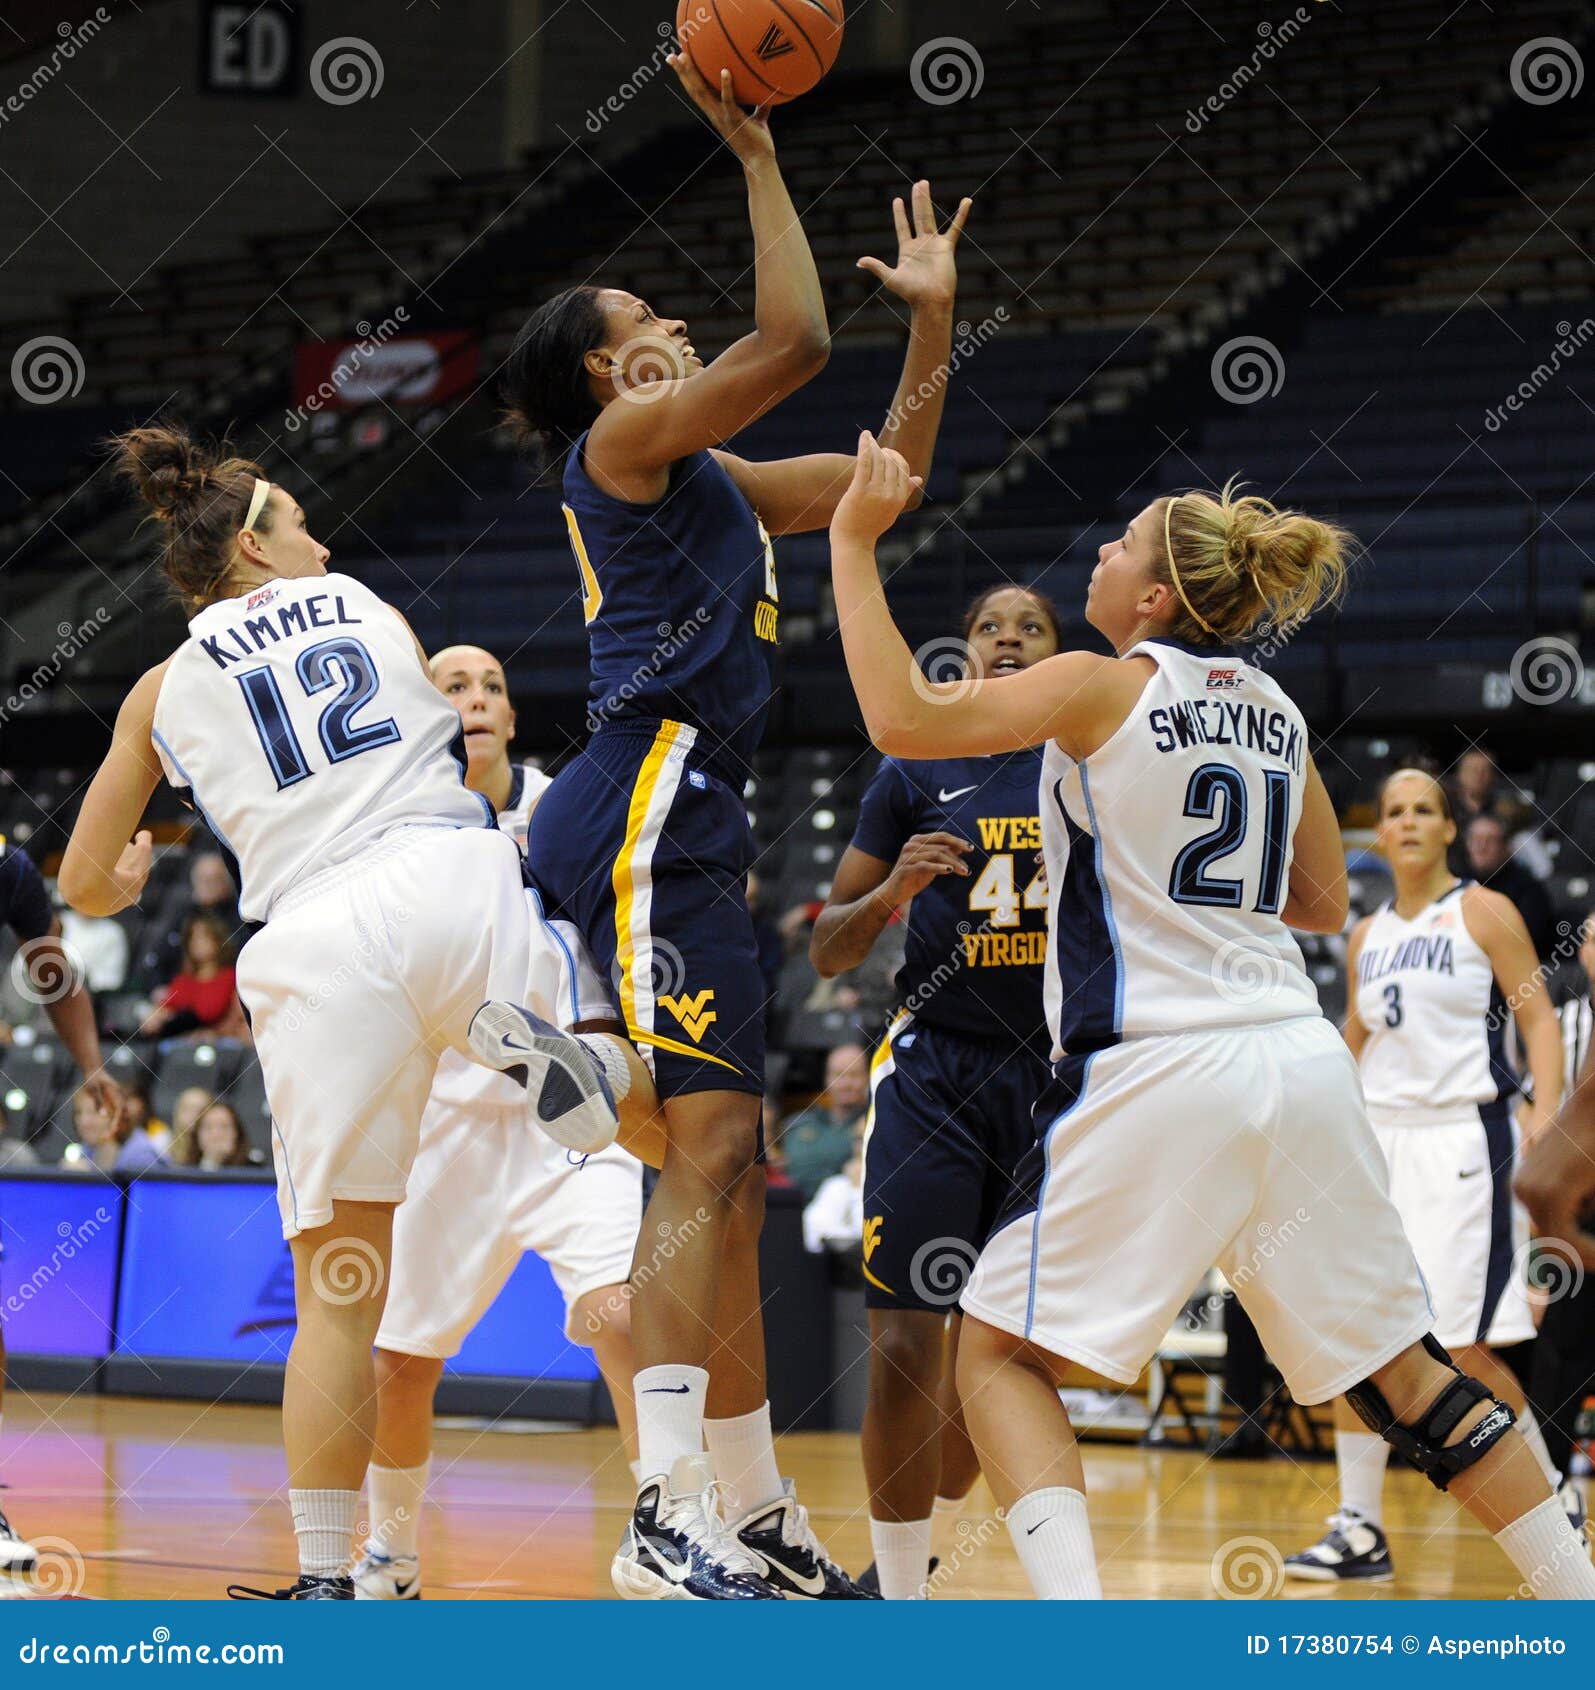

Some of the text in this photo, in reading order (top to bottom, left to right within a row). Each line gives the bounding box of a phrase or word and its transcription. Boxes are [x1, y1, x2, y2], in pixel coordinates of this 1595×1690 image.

[211, 7, 289, 85] ED
[199, 594, 363, 670] KIMMEL
[1206, 679, 1245, 688] EAST
[1207, 669, 1237, 679] BIG
[233, 636, 402, 792] 12
[1149, 699, 1303, 776] SWIEZYNSKI
[977, 816, 1043, 850] WES
[1168, 762, 1290, 914] 21
[1383, 983, 1402, 1029] 3
